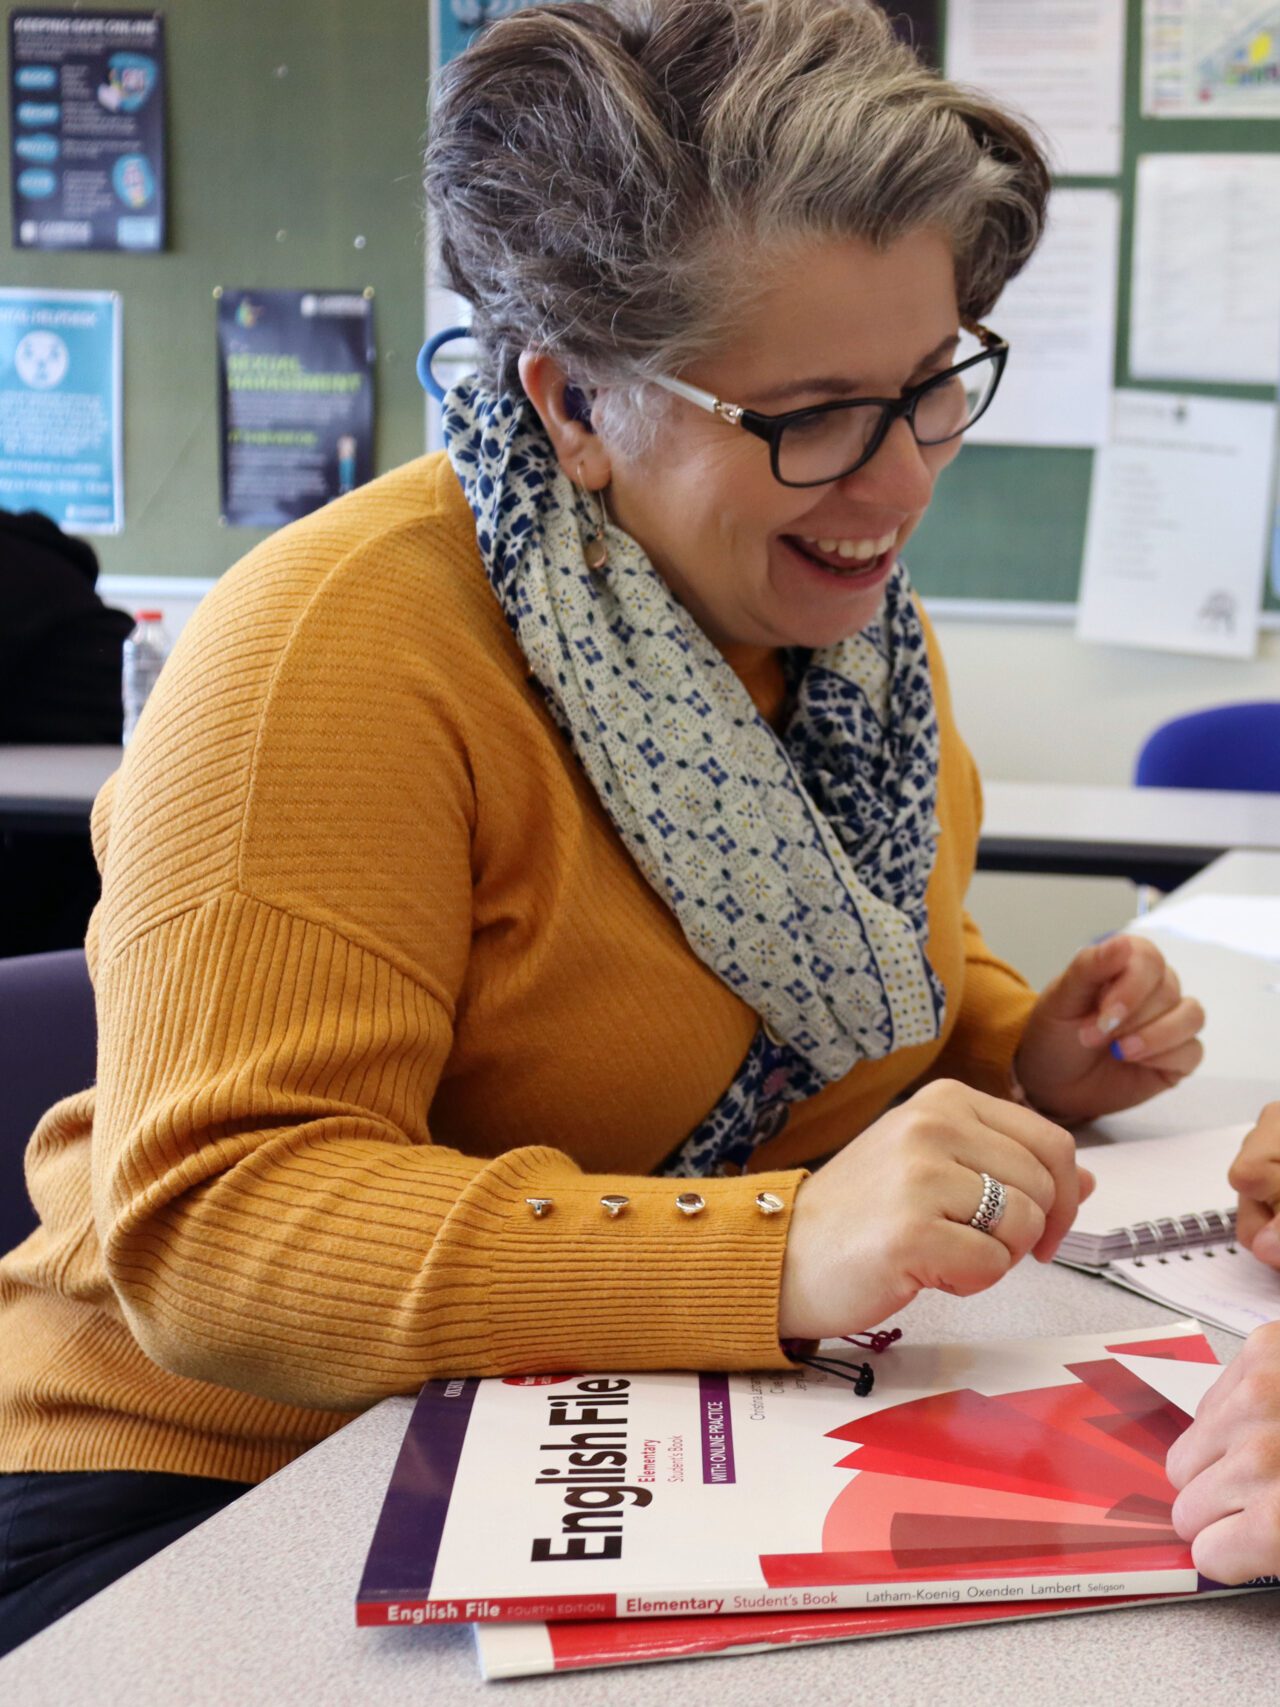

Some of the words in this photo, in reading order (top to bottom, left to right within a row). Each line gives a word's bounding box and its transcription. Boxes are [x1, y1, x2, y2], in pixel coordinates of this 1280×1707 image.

[547, 1378, 631, 1426] File
[707, 1400, 724, 1434] PRACTICE
[667, 1434, 683, 1451] Book
[709, 1434, 726, 1462] ONLINE
[638, 1439, 661, 1483] Elementary
[667, 1452, 684, 1483] Student's
[711, 1463, 727, 1482] WITH
[531, 1432, 653, 1562] English
[626, 1597, 724, 1614] Elementary
[733, 1593, 798, 1609] Student's
[803, 1592, 838, 1606] Book
[866, 1588, 960, 1603] Latham-Koenig
[967, 1584, 1024, 1598] Oxenden
[1031, 1582, 1081, 1595] Lambert
[1087, 1582, 1125, 1594] Seligson
[387, 1601, 458, 1624] English
[465, 1601, 501, 1618] File
[507, 1605, 554, 1616] FOURTH
[557, 1603, 606, 1615] EDITION
